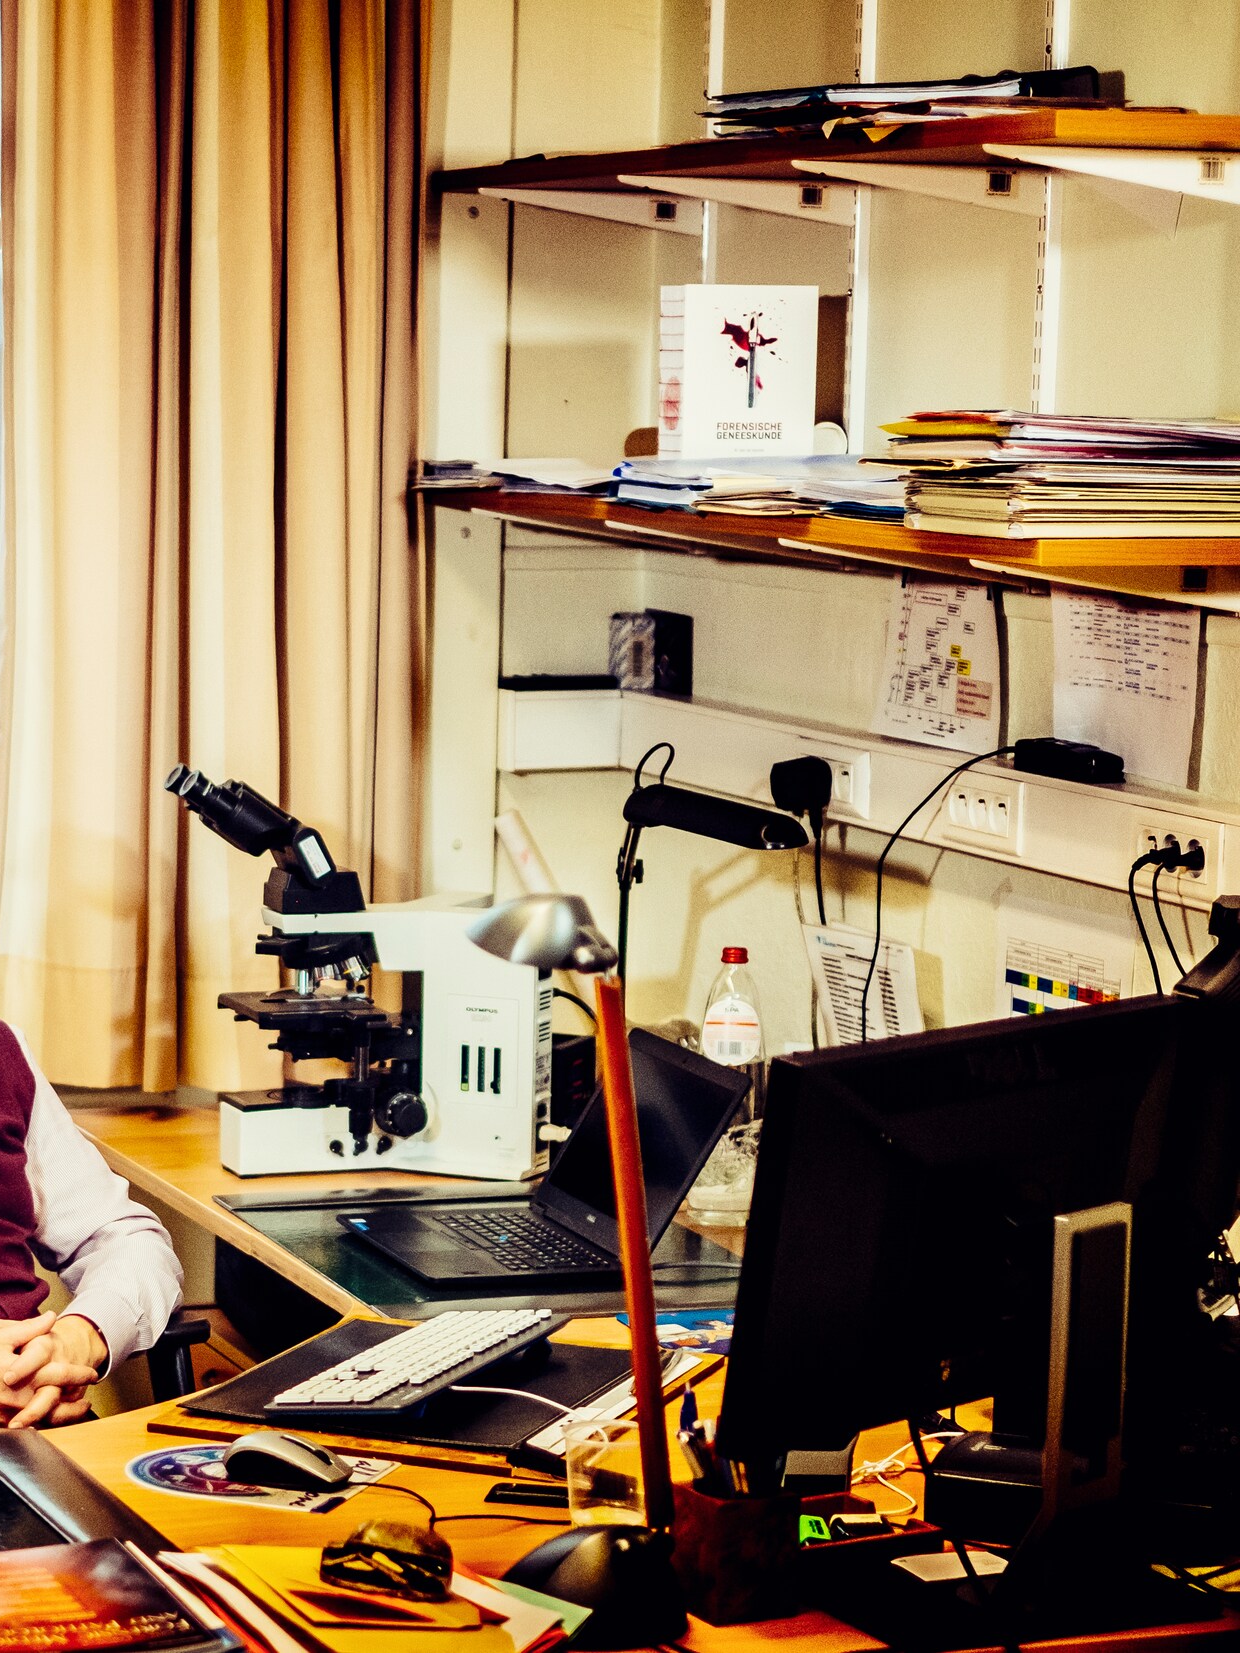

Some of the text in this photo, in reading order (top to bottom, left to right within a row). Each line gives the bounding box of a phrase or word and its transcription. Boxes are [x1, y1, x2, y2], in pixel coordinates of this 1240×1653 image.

[716, 422, 782, 431] FORENSISCHE
[716, 431, 782, 440] GENEESKUNDE
[465, 1006, 498, 1014] OLYMPUS
